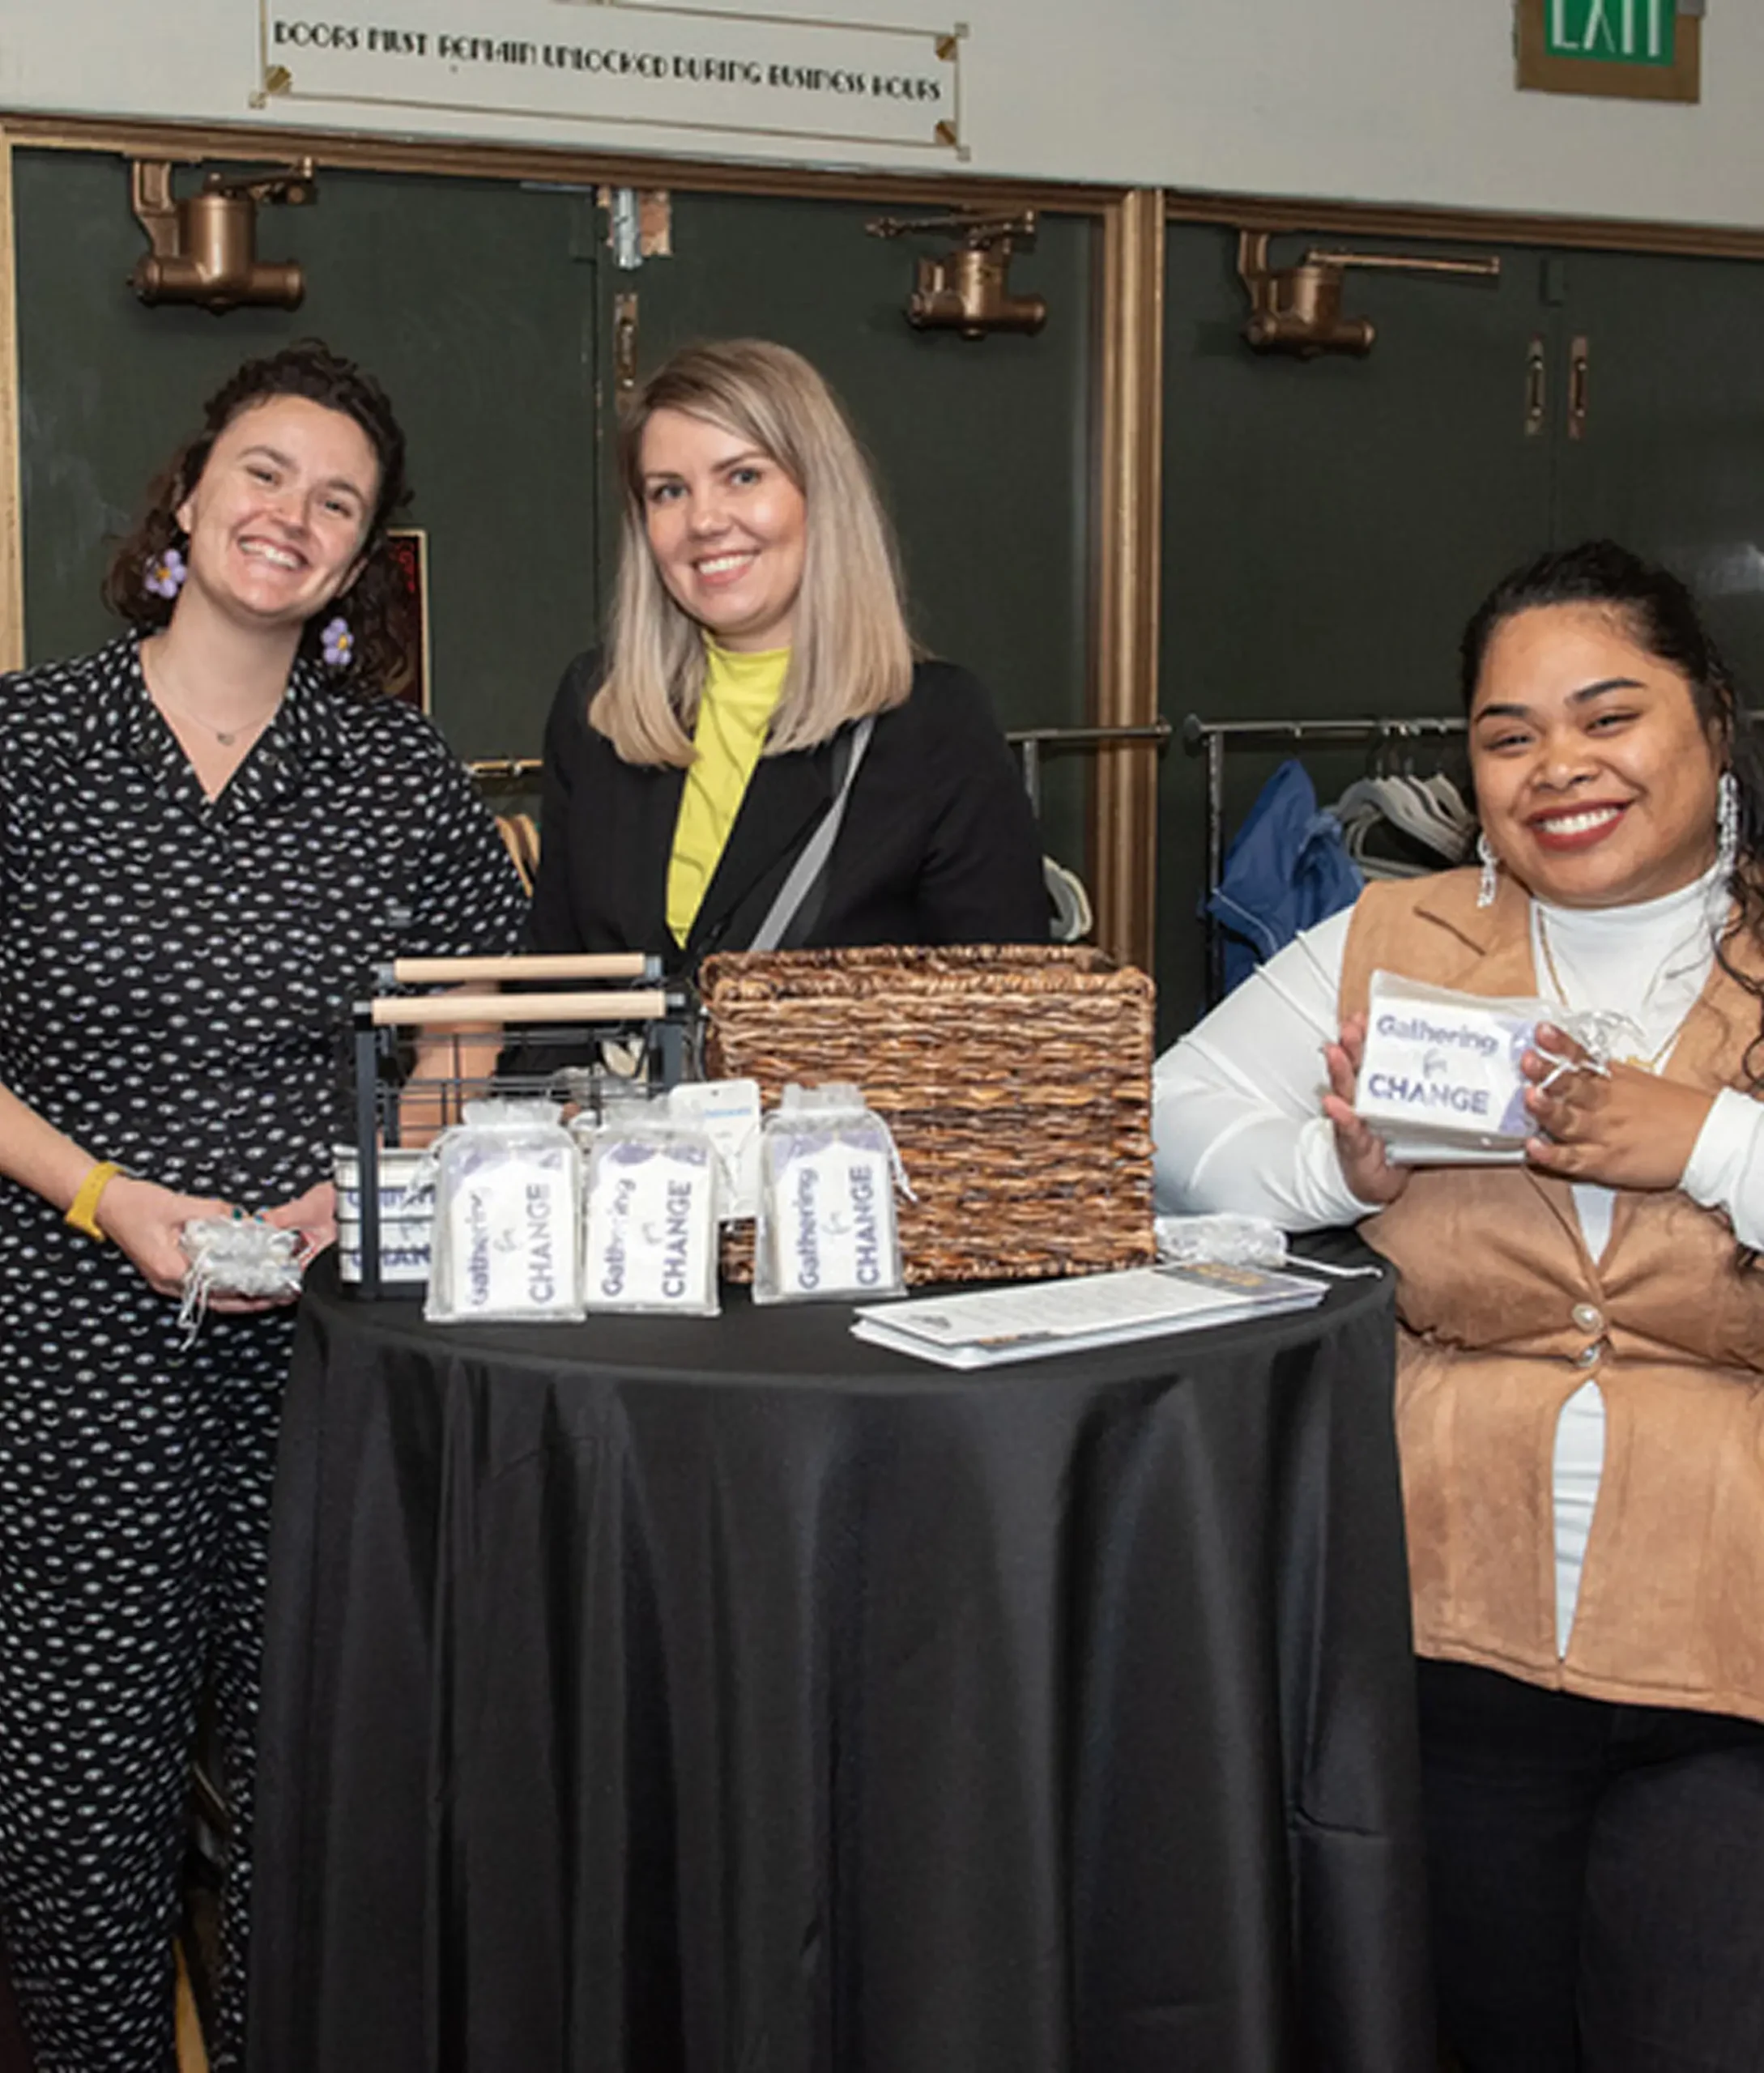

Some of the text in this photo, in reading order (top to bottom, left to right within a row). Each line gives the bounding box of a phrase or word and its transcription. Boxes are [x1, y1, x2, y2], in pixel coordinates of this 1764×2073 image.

[273, 20, 942, 102] DOORS MUST REMAIN UNLOCKED DURING BUSINESS HOURS
[1377, 1014, 1498, 1057] Gathering
[1369, 1072, 1489, 1116] CHANGE
[526, 1182, 556, 1304] CHANGE
[661, 1179, 692, 1299] CHANGE
[849, 1165, 881, 1286] CHANGE
